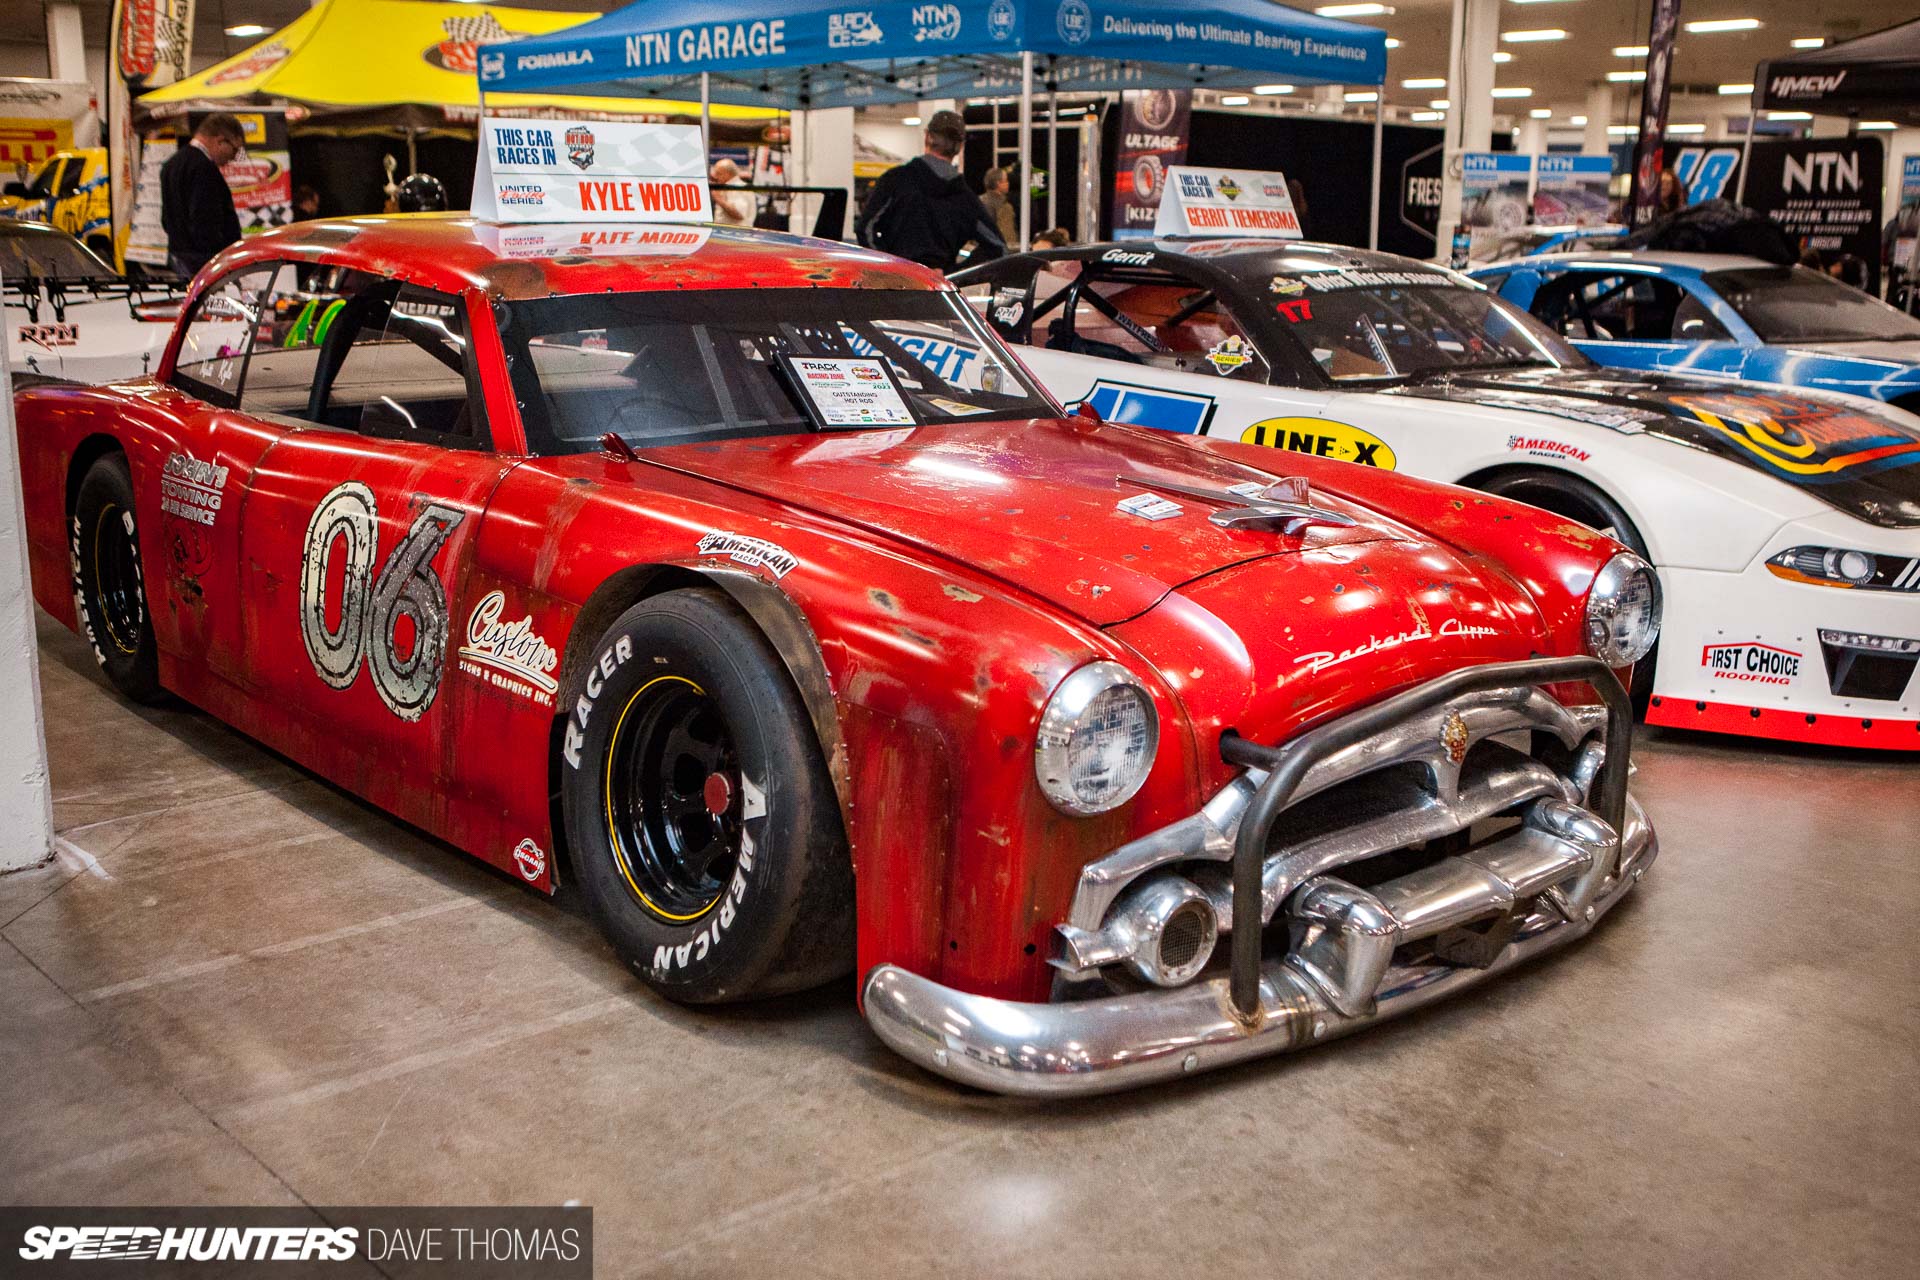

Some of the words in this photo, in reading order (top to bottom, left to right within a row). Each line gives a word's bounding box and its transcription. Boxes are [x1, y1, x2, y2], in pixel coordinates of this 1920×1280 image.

[625, 32, 671, 68] NTN
[677, 20, 786, 63] GARAGE
[1103, 15, 1173, 41] Delivering
[1176, 22, 1197, 39] the
[1200, 23, 1251, 46] Ultimate
[1254, 30, 1301, 56] Bearing
[1304, 37, 1367, 61] Experience
[517, 49, 594, 71] FORMULA
[494, 128, 523, 146] THIS
[528, 129, 553, 147] CAR
[1125, 133, 1180, 149] ULTAGE
[497, 147, 540, 165] RACES
[543, 148, 557, 165] IN
[1178, 174, 1194, 184] THIS
[1195, 175, 1210, 187] CAR
[1782, 152, 1860, 194] NTN
[499, 185, 542, 193] UNITED
[579, 182, 635, 211] KYLE
[638, 183, 702, 212] WOOD
[1186, 207, 1229, 228] GERRIT
[1230, 208, 1299, 230] TIEMERSMA
[1102, 249, 1154, 265] Gerrit
[1276, 299, 1313, 323] 17
[18, 323, 79, 352] RPM
[801, 362, 840, 371] TRACK
[1511, 437, 1591, 462] AMERICAN
[161, 480, 222, 509] TOWING
[704, 535, 795, 575] AMERICAN
[732, 553, 758, 564] RACER
[300, 480, 466, 723] 06
[467, 590, 558, 672] Custom
[1293, 624, 1432, 675] Packard
[1438, 618, 1499, 640] Clipper
[1701, 645, 1742, 670] FIRST
[1746, 647, 1799, 676] CHOICE
[459, 661, 482, 677] SIGNS
[491, 674, 533, 698] GRAPHICS
[533, 690, 553, 707] INC.
[1714, 671, 1791, 685] ROOFING
[564, 634, 633, 770] RACER
[653, 771, 768, 970] AMERICAN
